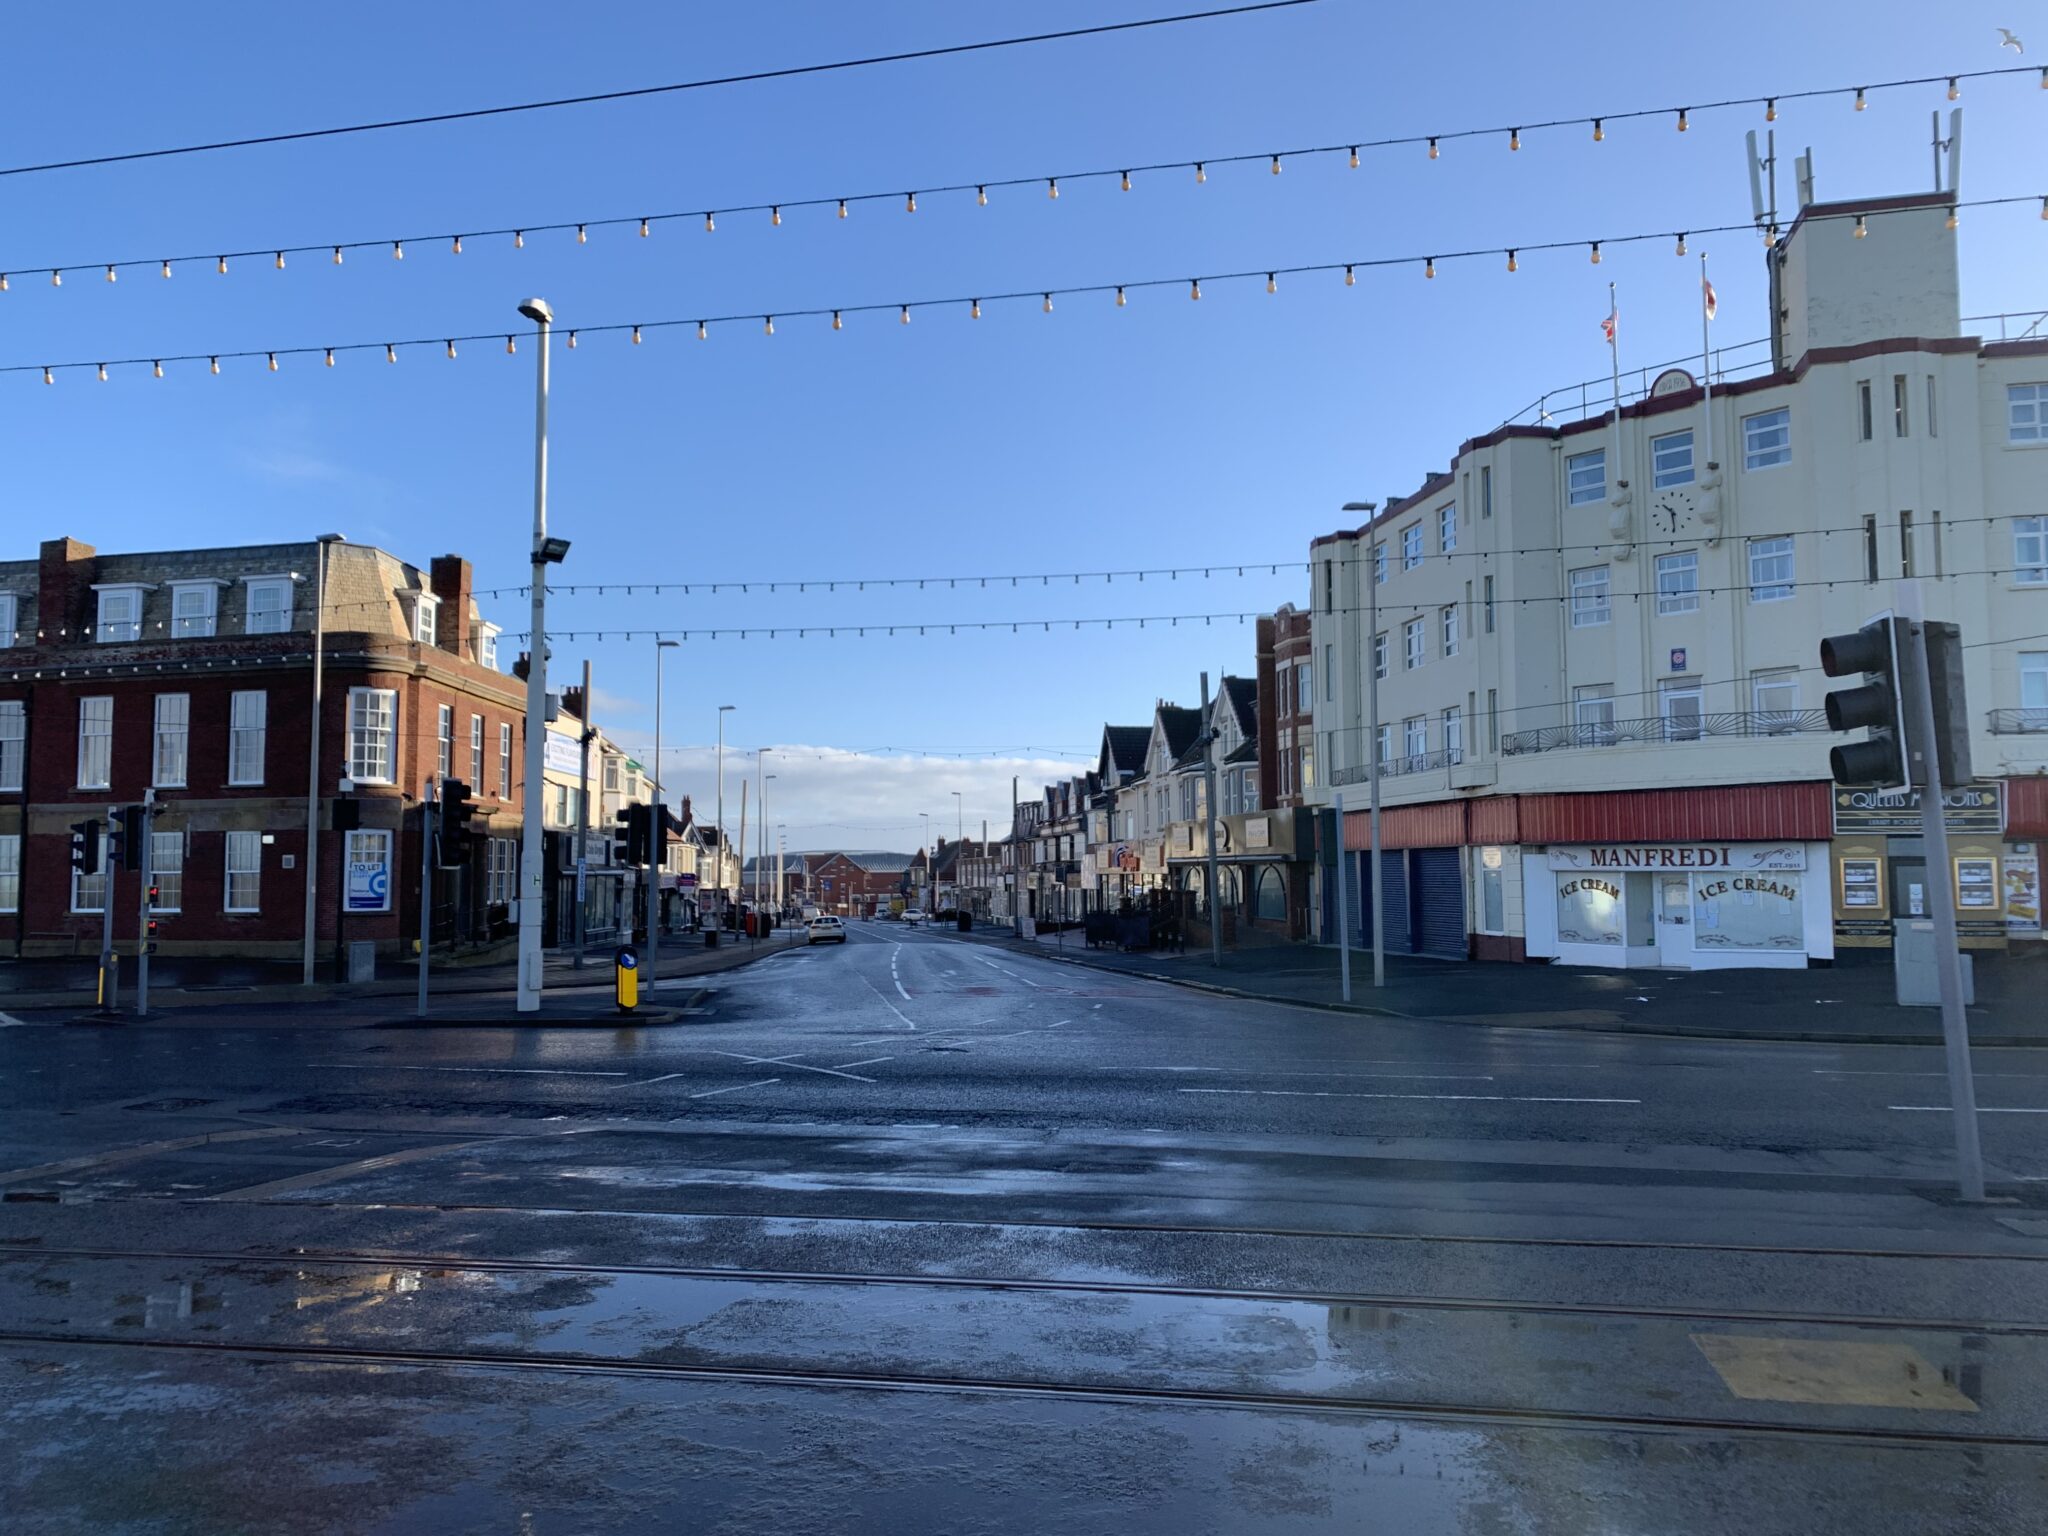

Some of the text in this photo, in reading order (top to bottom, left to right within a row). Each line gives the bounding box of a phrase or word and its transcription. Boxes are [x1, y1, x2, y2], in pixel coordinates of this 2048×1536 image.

[1590, 848, 1731, 867] MANFREDI
[1560, 878, 1620, 900] ICE CREAM
[1698, 878, 1796, 901] ICE CREAM
